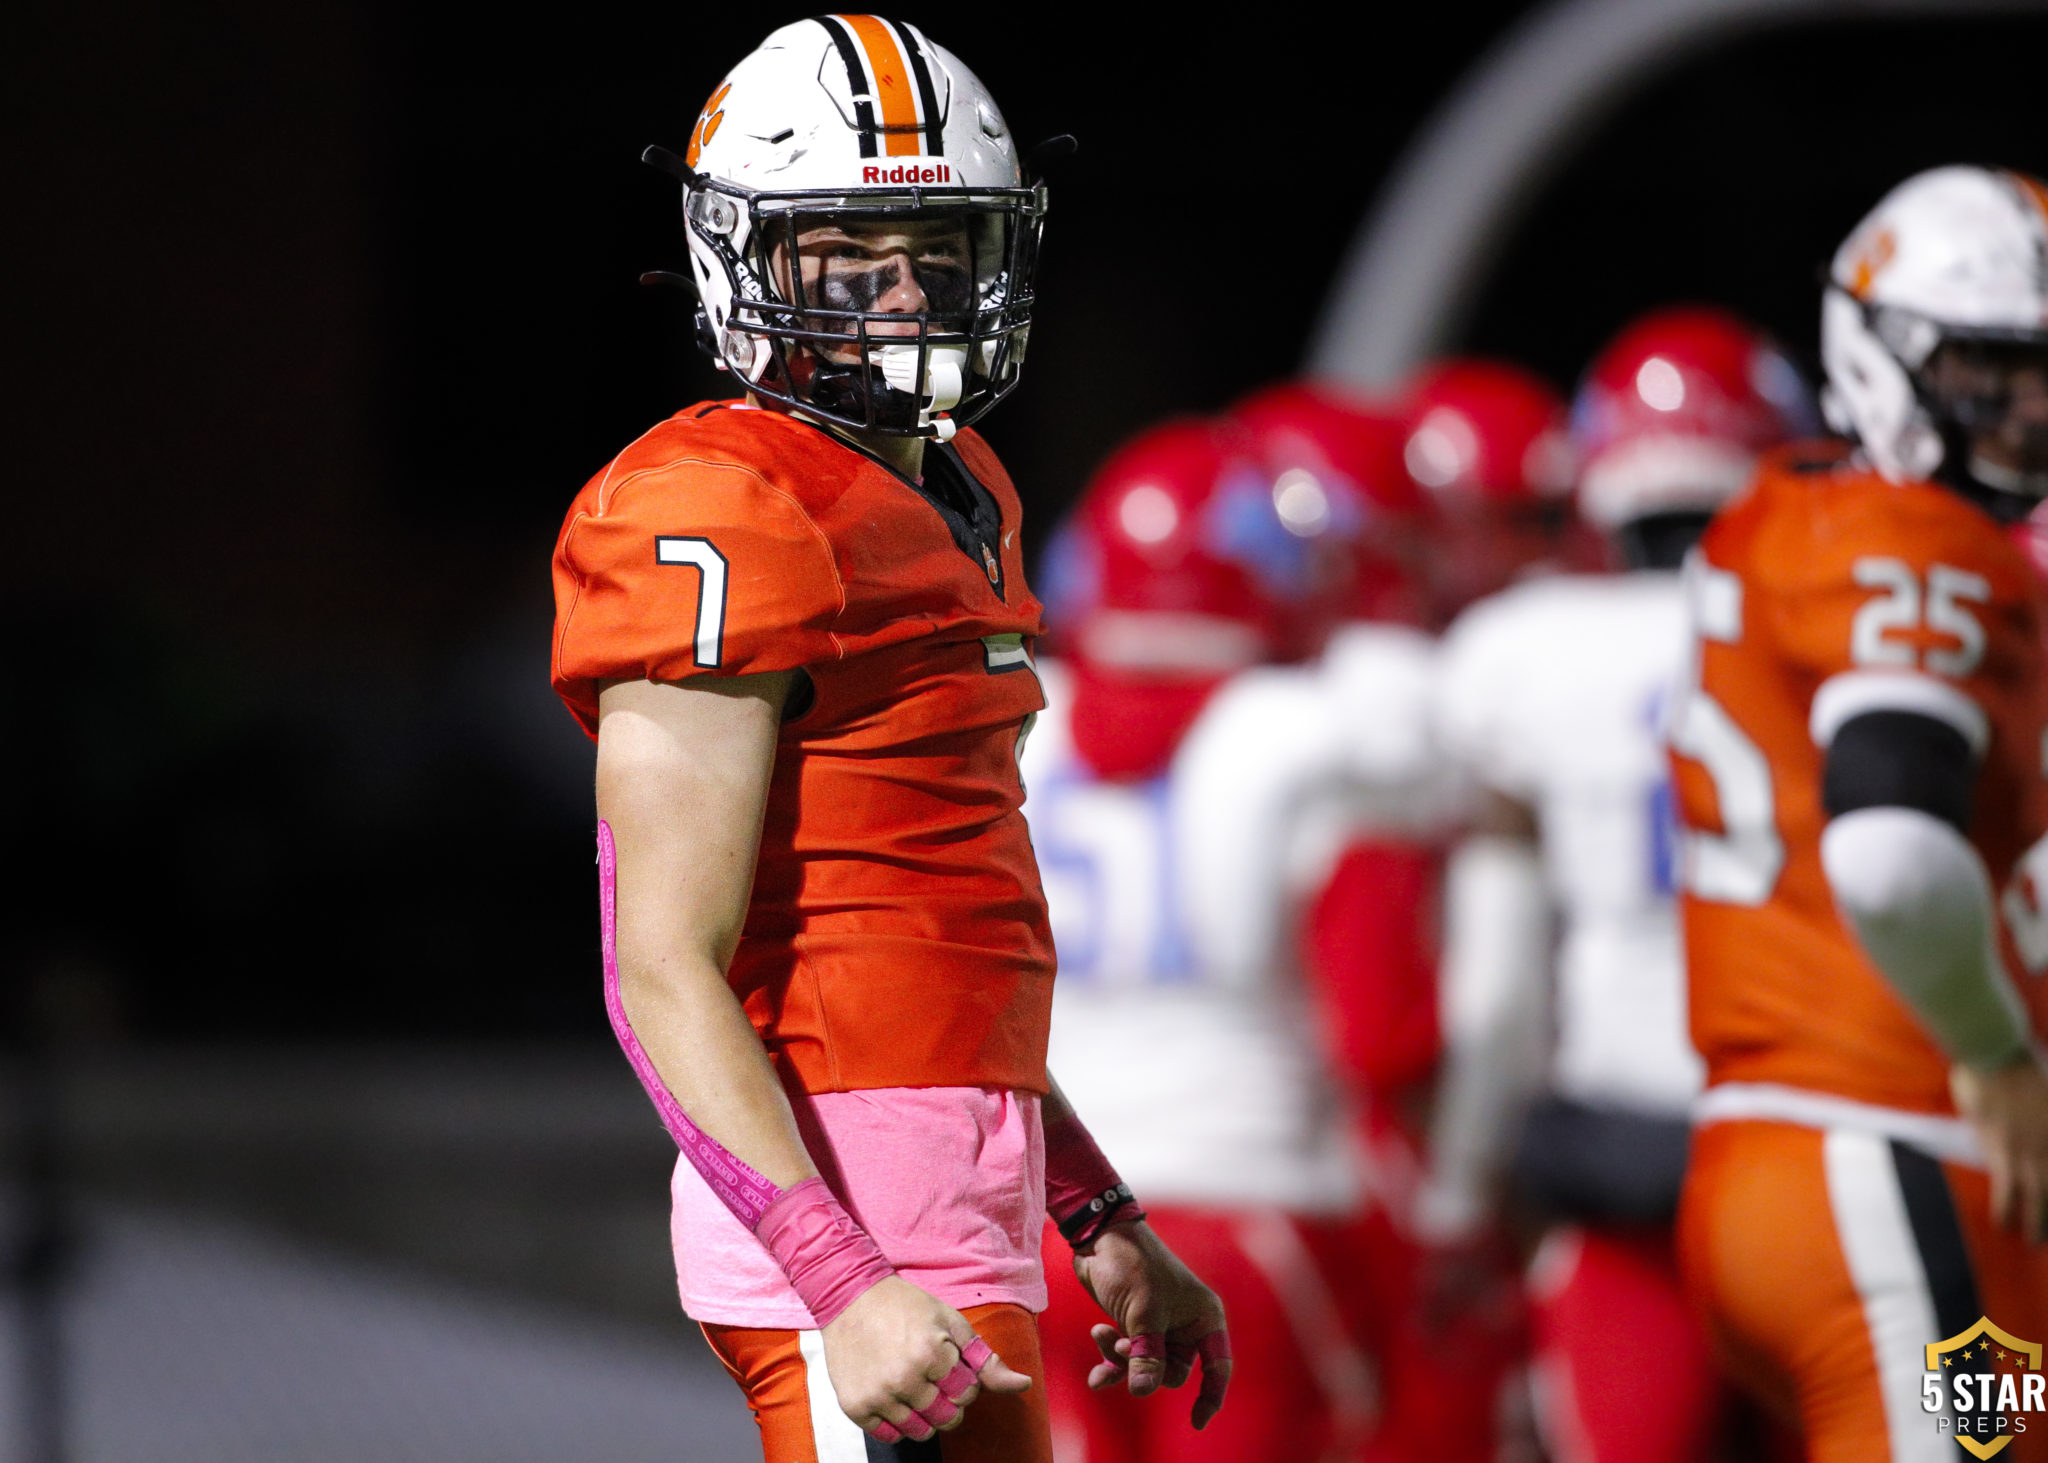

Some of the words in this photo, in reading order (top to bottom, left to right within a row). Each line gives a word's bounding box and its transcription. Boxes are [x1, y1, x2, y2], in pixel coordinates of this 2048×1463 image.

[863, 165, 950, 184] Riddell
[655, 535, 729, 669] 7
[1852, 556, 1993, 676] 25
